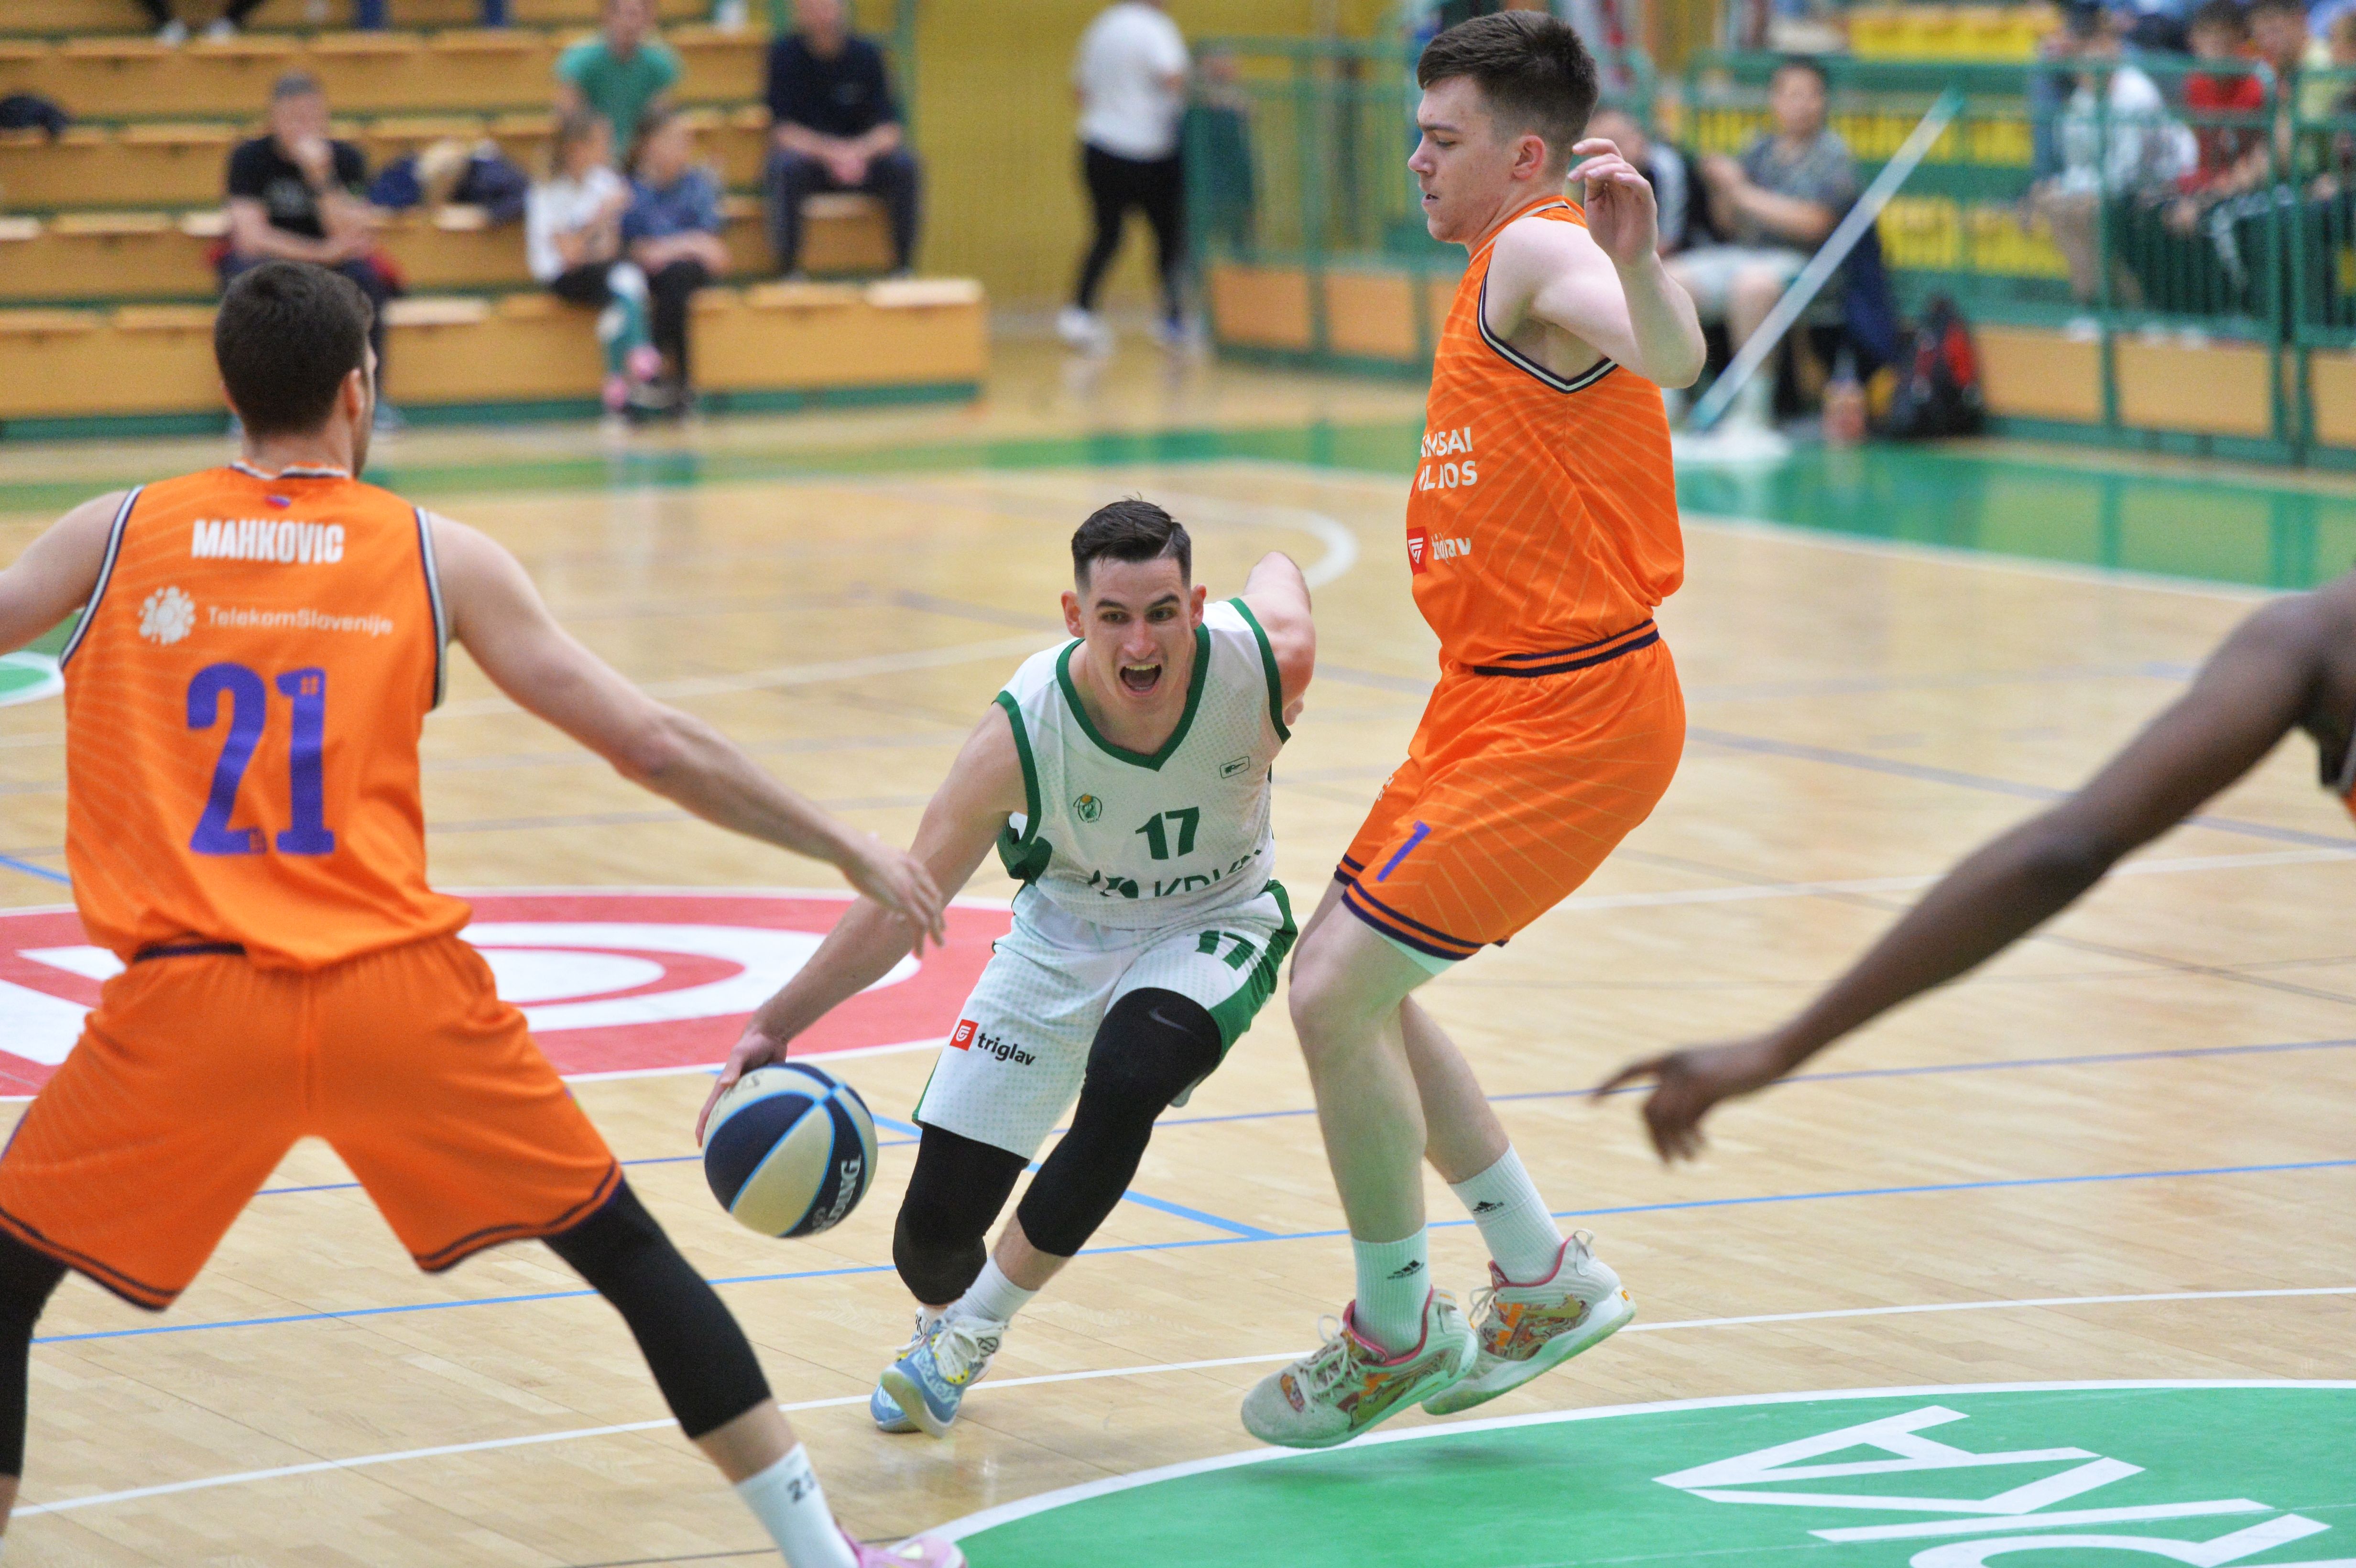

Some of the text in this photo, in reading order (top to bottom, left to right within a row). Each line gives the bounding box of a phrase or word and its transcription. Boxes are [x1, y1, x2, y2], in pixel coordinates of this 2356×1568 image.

[1419, 460, 1478, 491] LIOS
[192, 519, 345, 564] MAHKOVIC
[186, 663, 335, 855] 21
[1135, 806, 1200, 860] 17
[1195, 930, 1256, 971] 17
[977, 1033, 1036, 1066] triglav
